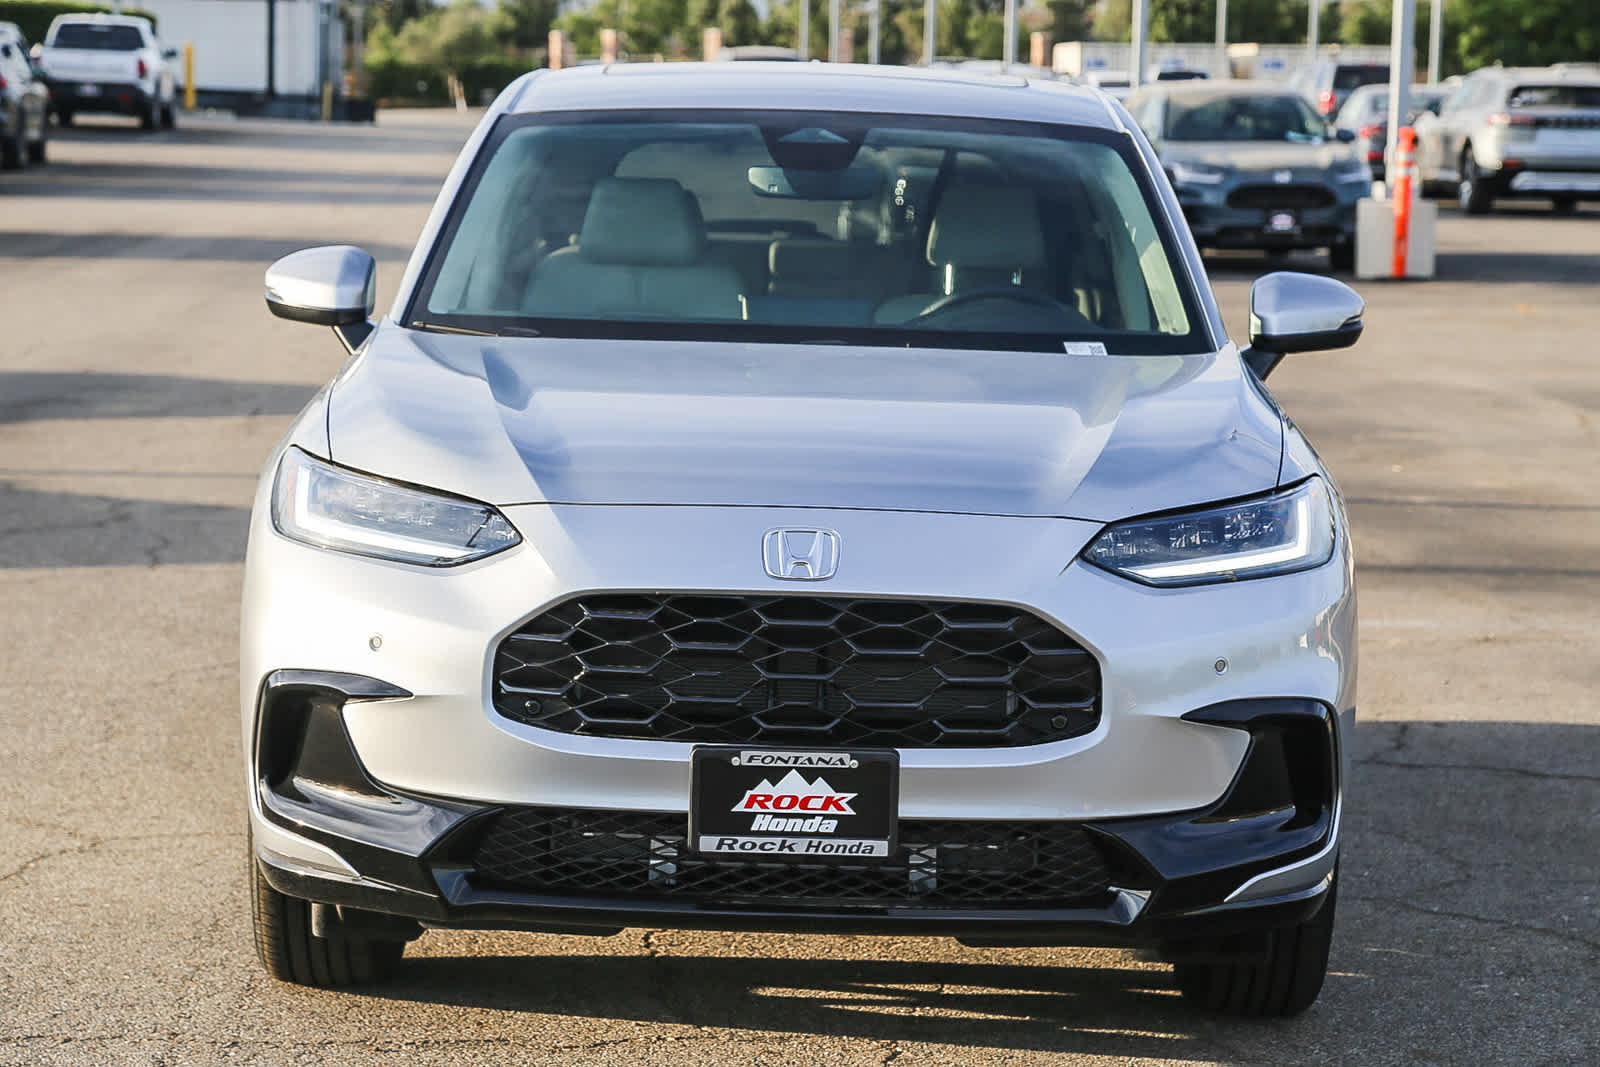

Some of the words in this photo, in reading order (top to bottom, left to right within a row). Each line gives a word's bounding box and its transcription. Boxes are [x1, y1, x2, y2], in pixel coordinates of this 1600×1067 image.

[747, 754, 847, 766] FONTANA
[743, 793, 850, 812] ROCK
[750, 814, 839, 833] Honda
[716, 837, 800, 853] Rock
[804, 840, 876, 855] Honda
